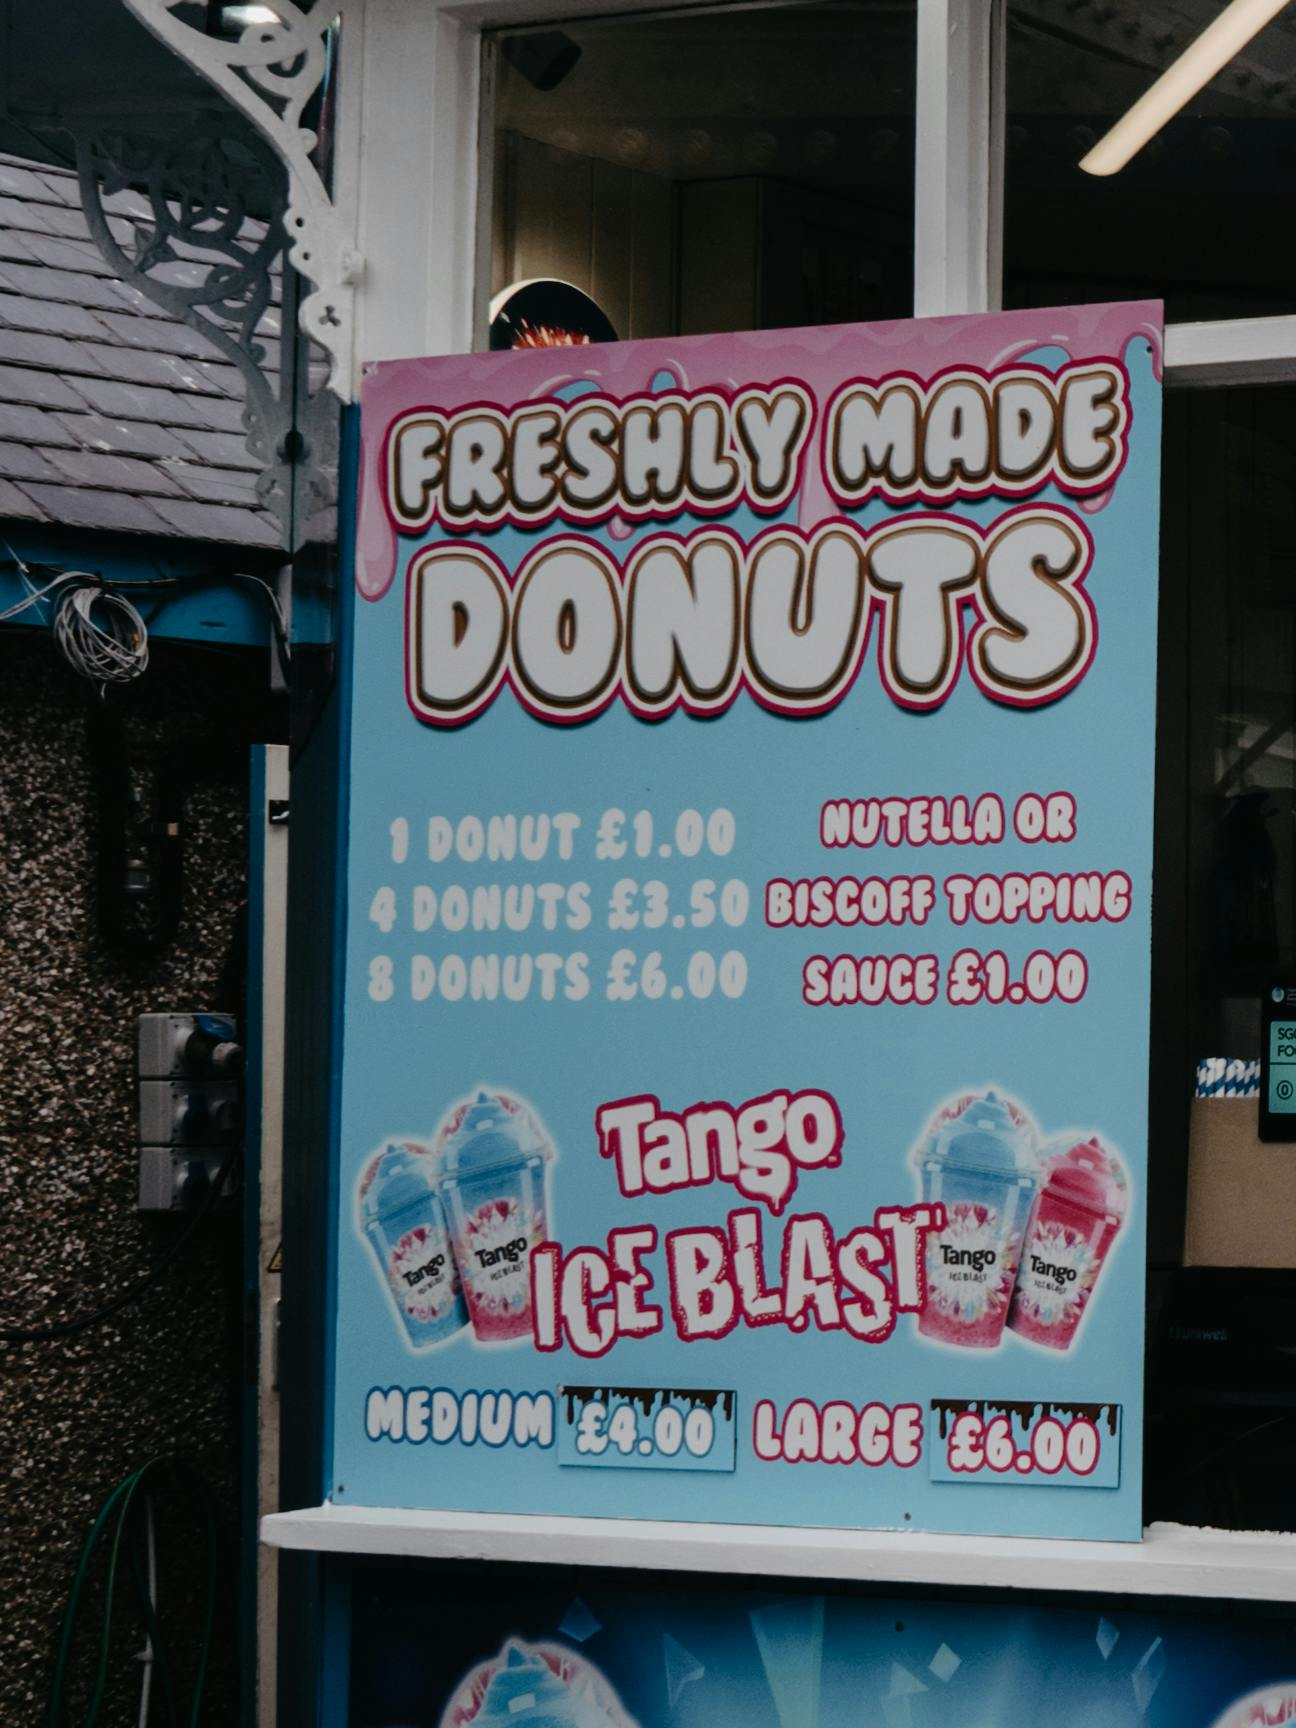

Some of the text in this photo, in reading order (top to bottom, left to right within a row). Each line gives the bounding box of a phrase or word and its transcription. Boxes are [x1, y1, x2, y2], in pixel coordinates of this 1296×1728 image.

[383, 355, 1133, 534] FRESHLY MADE
[405, 503, 1098, 726] DONUTS
[390, 809, 736, 863] 1 DONUT £1.00
[820, 791, 1077, 847] NUTELLA OR
[369, 878, 749, 932] 4 DONUTS £3.50
[765, 870, 1132, 929] BISCOFF TOPPING
[369, 948, 748, 1001] 8 DONUTS £6.00
[803, 948, 1088, 1006] SAUCE £1.00
[597, 1089, 841, 1212] Tango
[402, 1254, 445, 1287] Tango
[475, 1237, 527, 1268] Tango
[531, 1203, 945, 1357] ICE BLAST
[940, 1244, 996, 1272] Tango
[1030, 1255, 1077, 1285] Tango
[365, 1385, 1102, 1476] MEDIUM £4.00 LARGE £6.00
